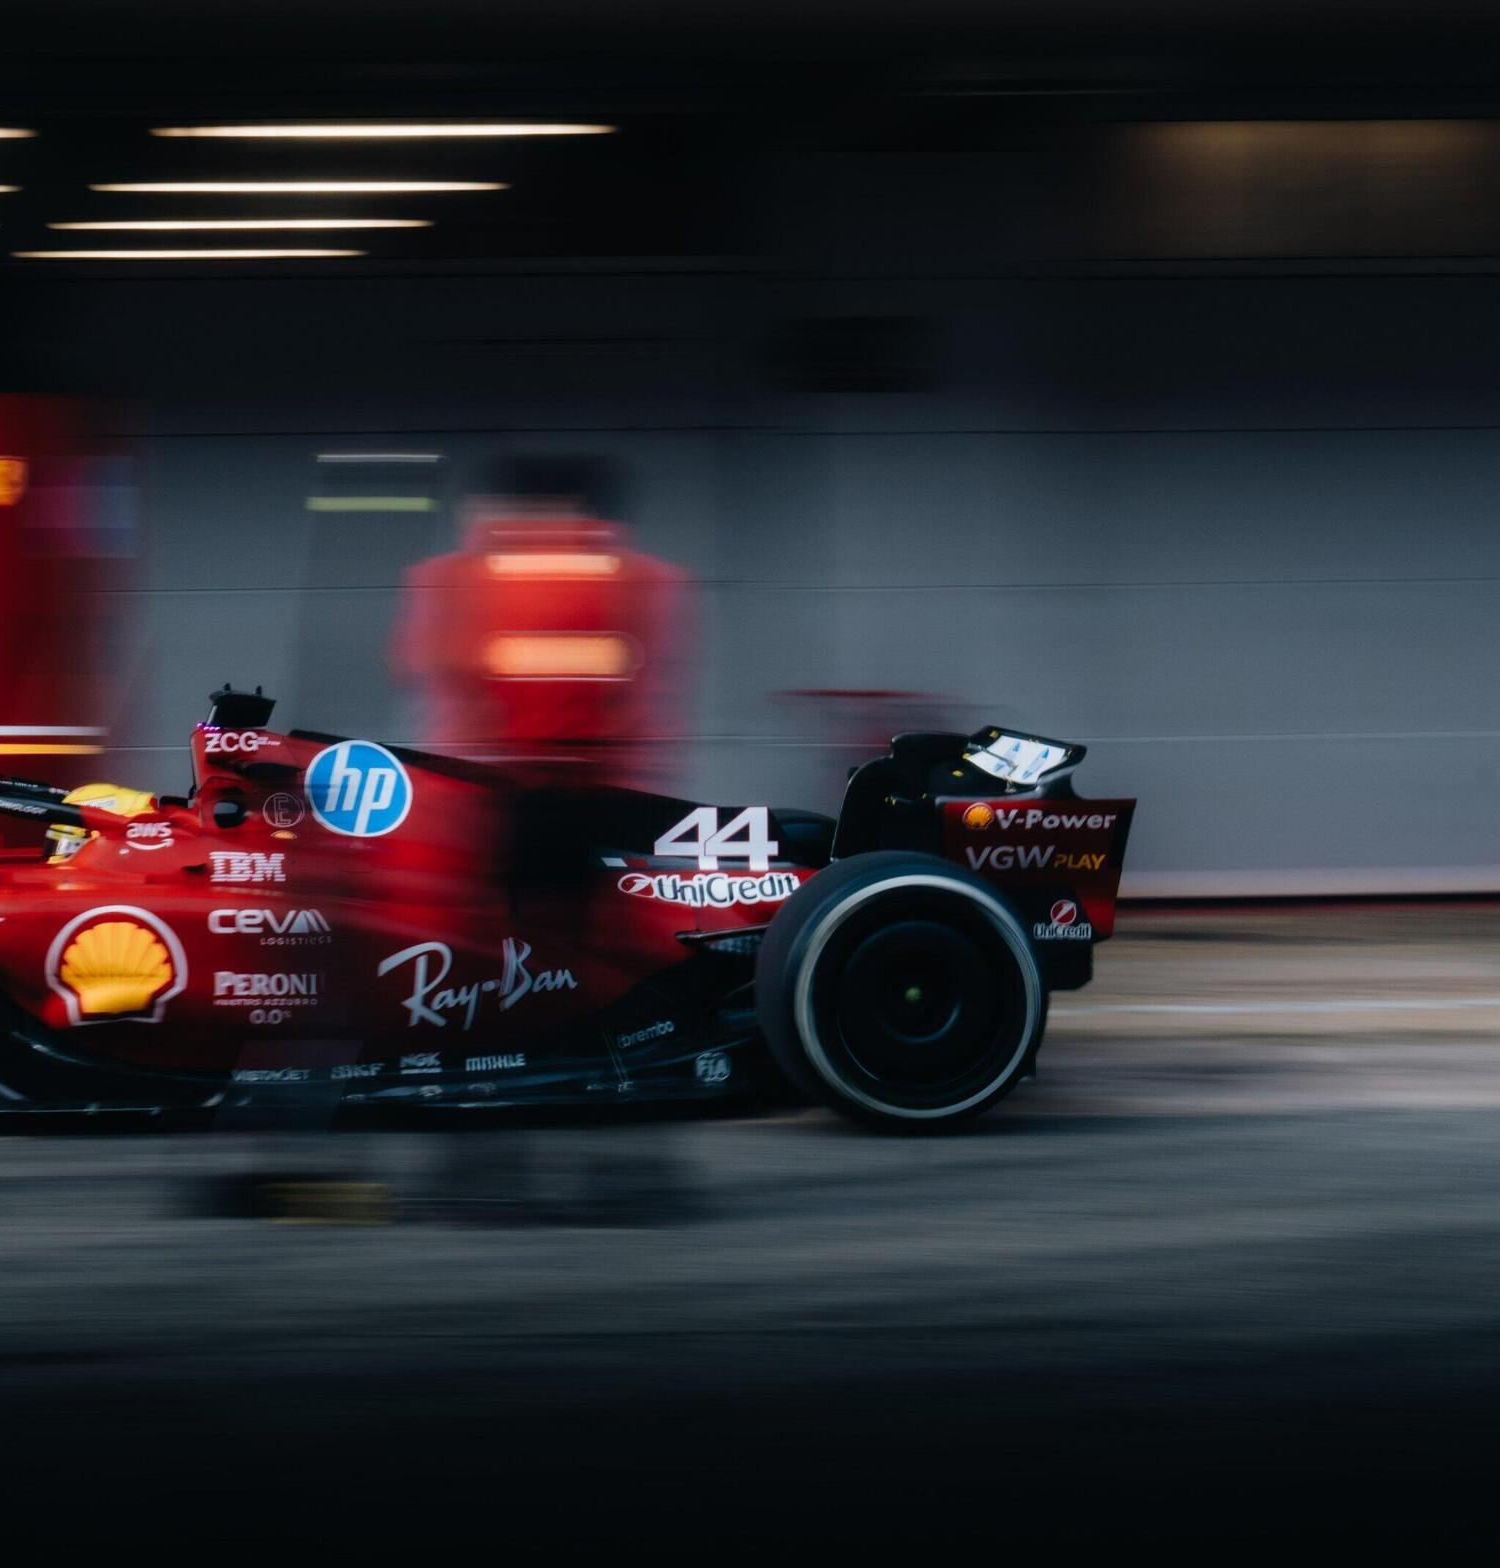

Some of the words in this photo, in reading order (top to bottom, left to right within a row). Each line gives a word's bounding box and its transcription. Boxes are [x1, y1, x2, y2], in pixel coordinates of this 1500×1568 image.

[204, 731, 260, 753] ZCG
[323, 741, 399, 836] hp
[994, 808, 1117, 830] V-Power
[654, 806, 780, 871] 44
[209, 850, 287, 882] IBM
[964, 845, 1056, 871] VGW
[1053, 852, 1107, 872] PLAY
[655, 873, 800, 907] UniCredit
[212, 971, 319, 997] PERONI
[376, 936, 579, 1032] Ray-Ban
